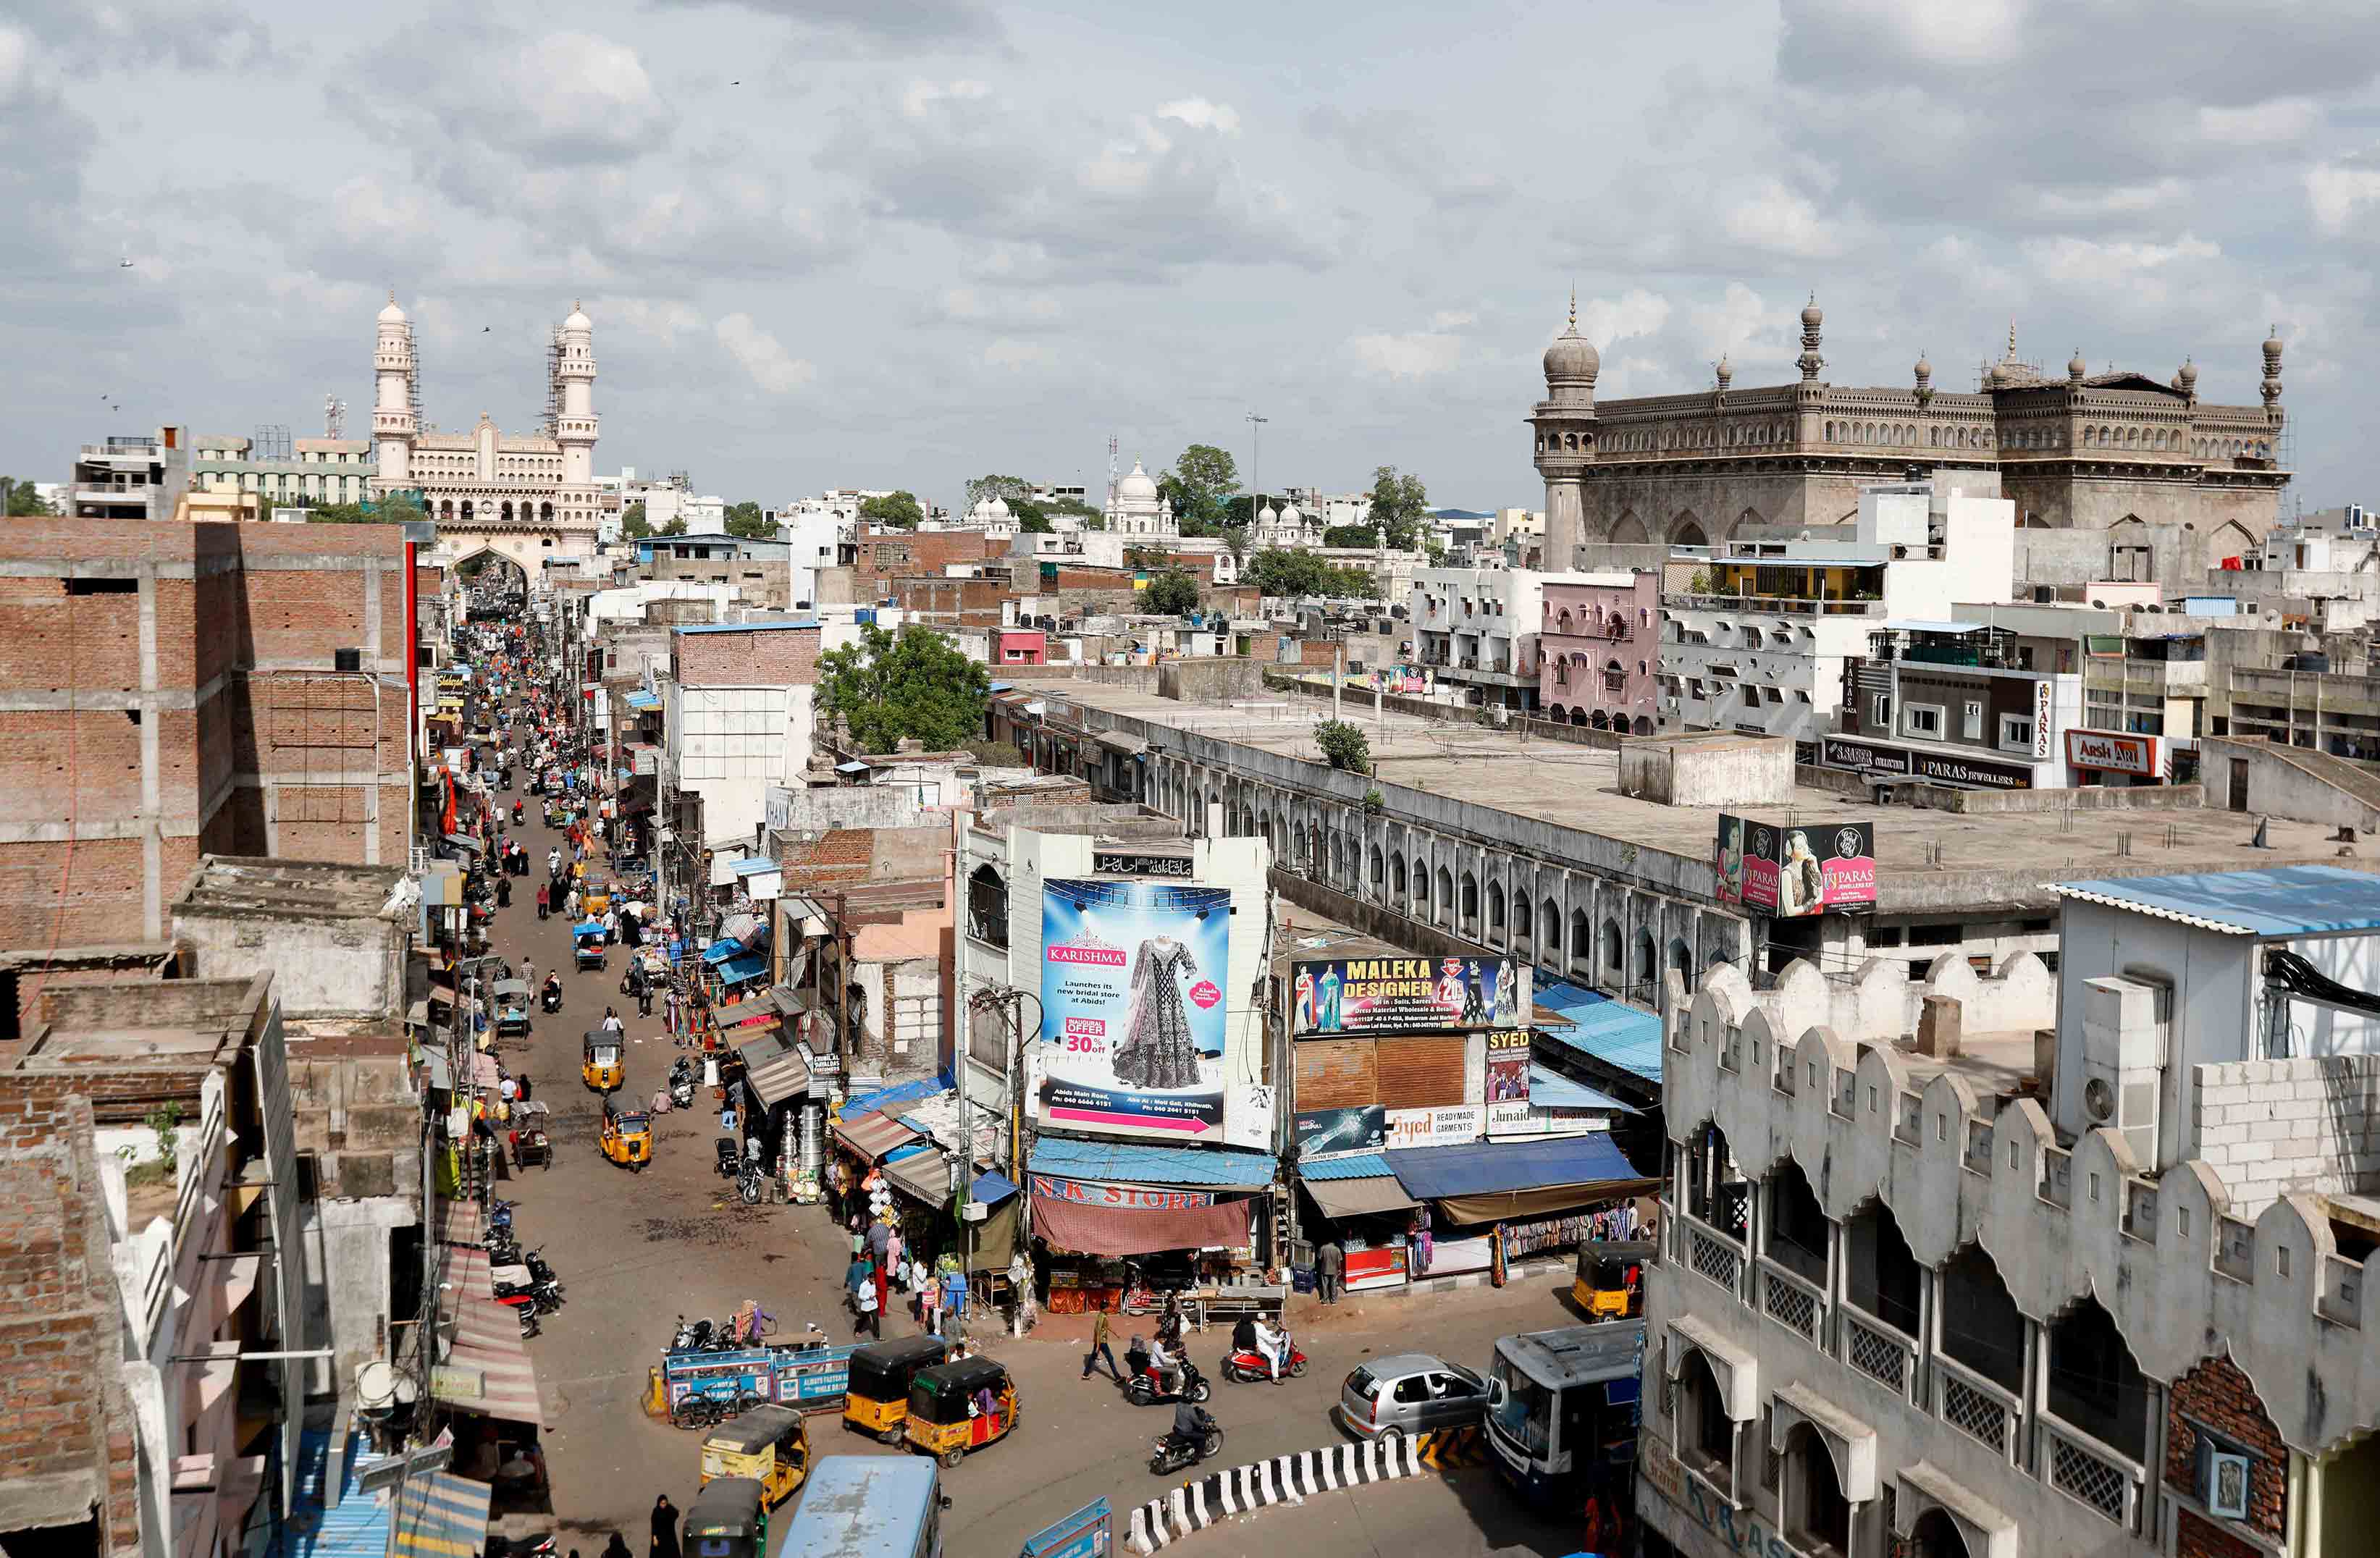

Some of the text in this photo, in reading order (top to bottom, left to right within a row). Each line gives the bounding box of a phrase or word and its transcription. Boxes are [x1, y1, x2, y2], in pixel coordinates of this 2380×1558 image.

[2038, 700, 2048, 756] PARAS
[1927, 761, 1967, 780] PARAS
[1968, 771, 2014, 786] JEWELLERS
[1753, 869, 1778, 887] PARAS
[1838, 869, 1874, 883] PARAS
[1051, 949, 1123, 964] KARISHMA
[1347, 960, 1431, 980] MALEKA
[1344, 982, 1433, 998] DESIGNER
[1068, 1024, 1103, 1035] OFFER
[1489, 1031, 1529, 1049] SYED
[1492, 1106, 1529, 1123] Junaid
[1392, 1113, 1431, 1142] Syed
[1437, 1111, 1475, 1121] READYMADE
[1437, 1122, 1473, 1133] GARMENTS
[1033, 1176, 1208, 1210] N.K. STORE
